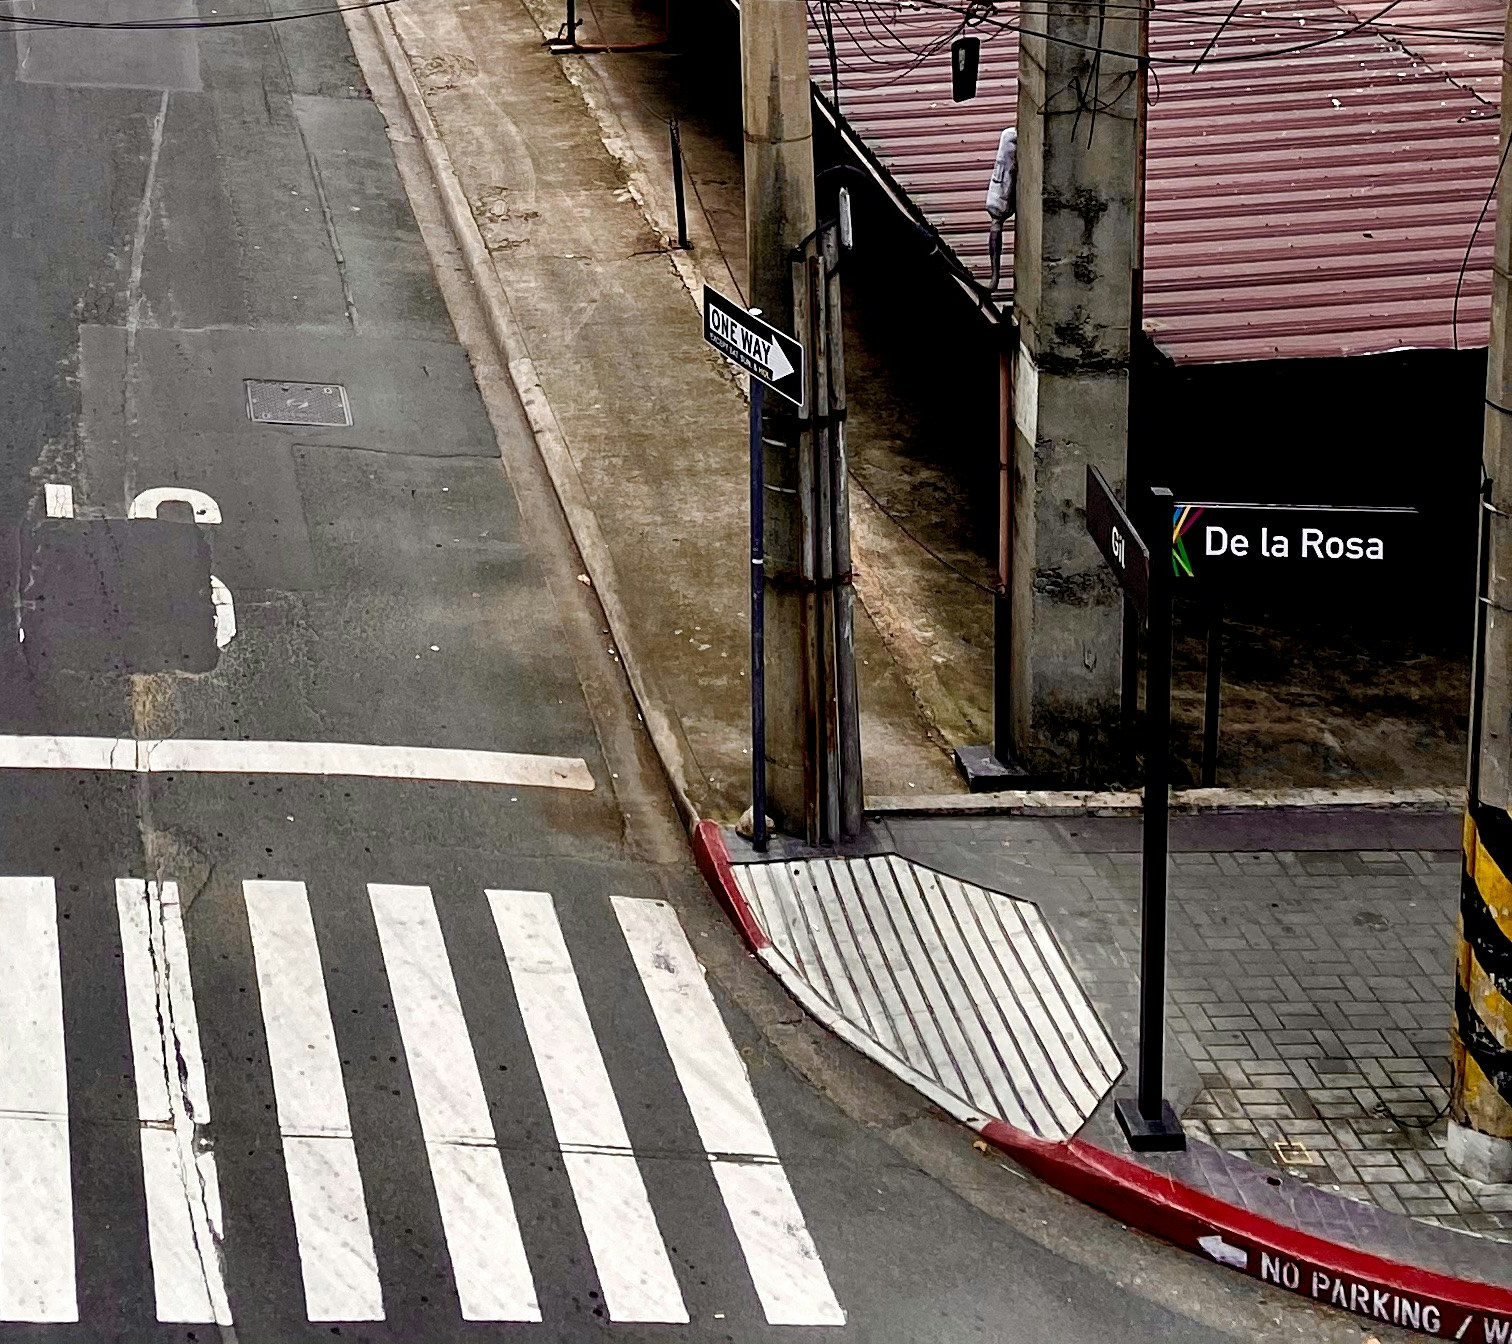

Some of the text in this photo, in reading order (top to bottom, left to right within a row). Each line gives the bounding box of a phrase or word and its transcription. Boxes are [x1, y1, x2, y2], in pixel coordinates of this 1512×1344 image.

[711, 308, 771, 365] ONE WAY
[1111, 525, 1126, 570] Gil
[1205, 525, 1384, 560] De la Rosa
[1260, 1251, 1300, 1289] NO
[1311, 1271, 1441, 1334] PARKING
